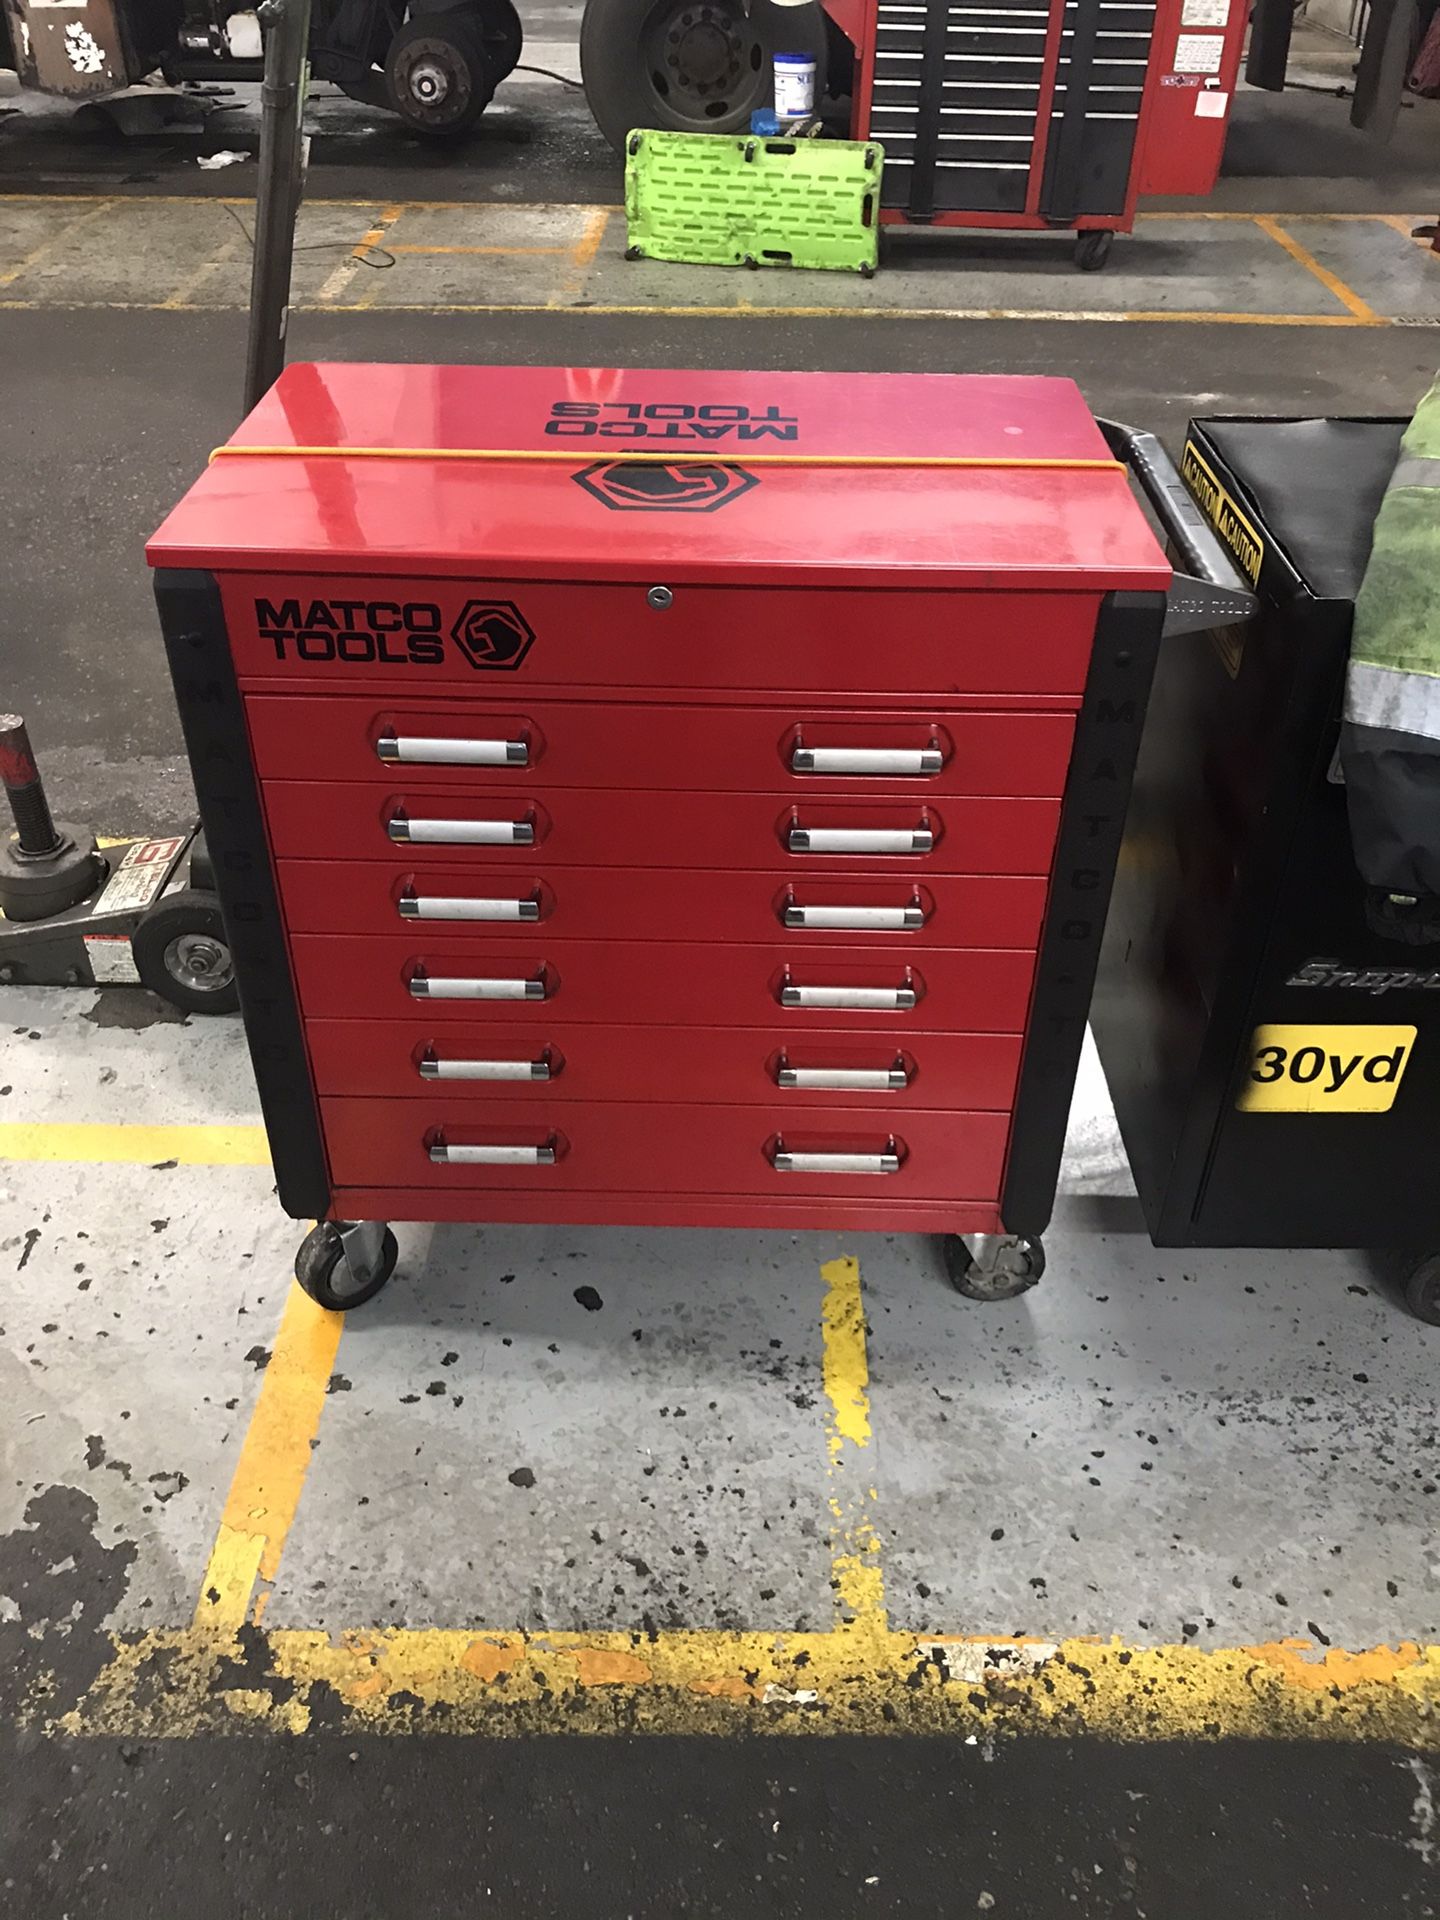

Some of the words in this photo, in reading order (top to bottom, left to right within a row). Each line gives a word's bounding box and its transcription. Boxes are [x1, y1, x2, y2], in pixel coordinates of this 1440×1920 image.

[551, 402, 798, 421] TOOLS
[545, 420, 798, 440] MATCO
[1191, 463, 1219, 522] CAUTION
[1227, 516, 1260, 581] CAUTION
[254, 598, 442, 633] MATCO
[259, 629, 445, 664] TOOLS
[1252, 1046, 1406, 1093] 30yd
